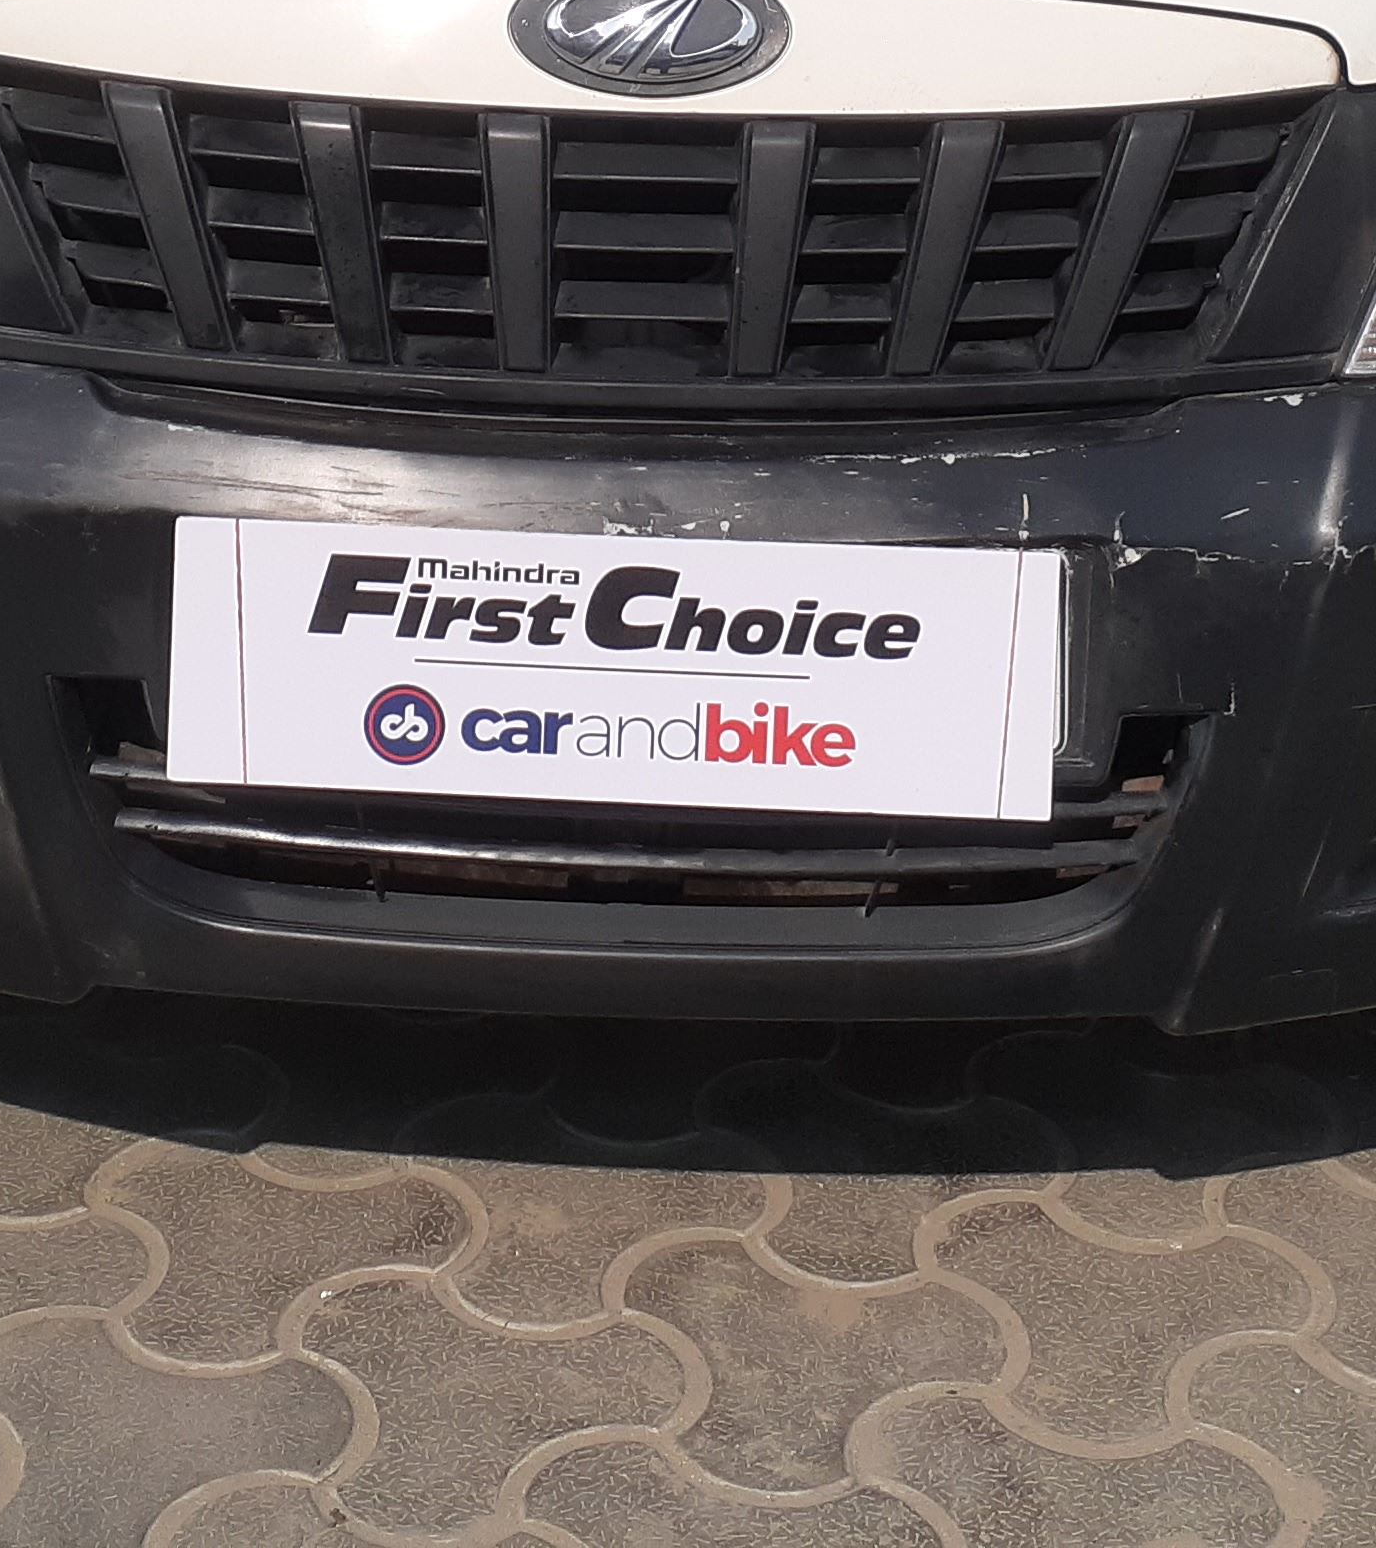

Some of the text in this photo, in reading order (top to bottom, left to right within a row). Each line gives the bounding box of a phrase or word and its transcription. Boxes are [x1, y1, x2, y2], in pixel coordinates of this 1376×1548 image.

[417, 557, 580, 585] Mahindra
[307, 553, 921, 660] First Choice
[460, 701, 856, 767] carandbike
